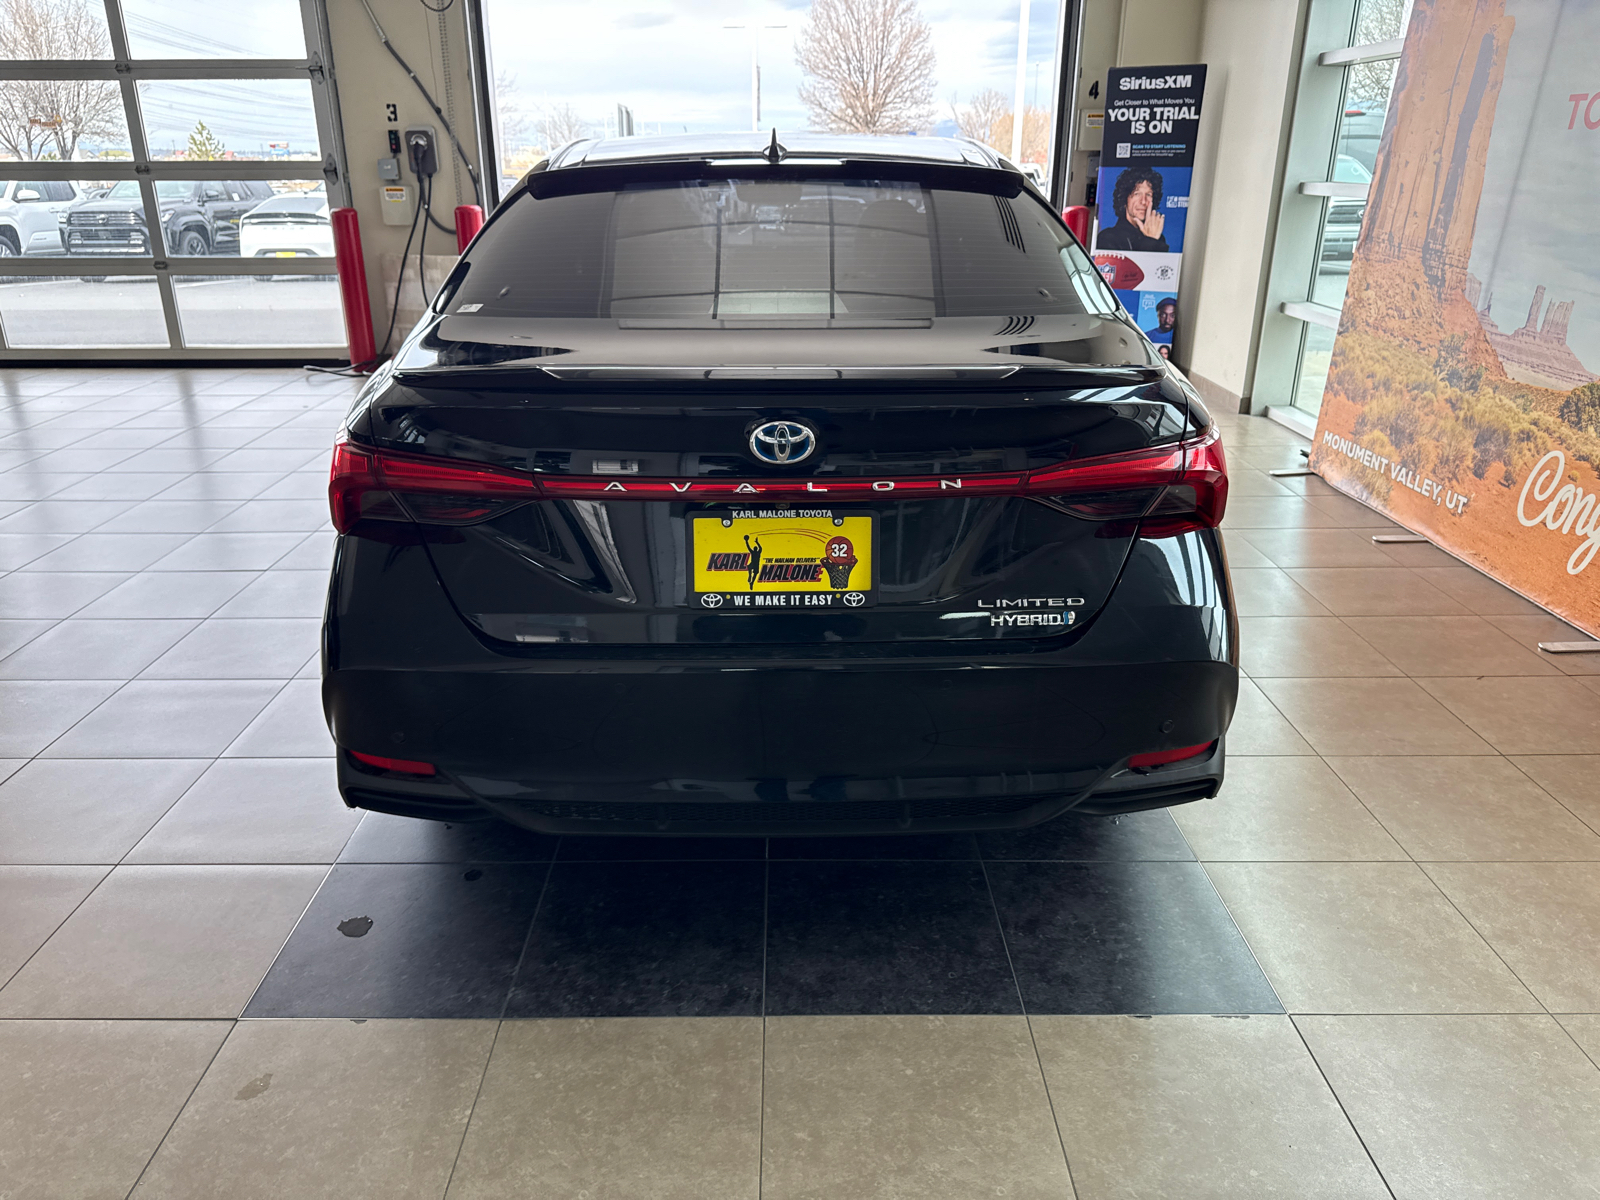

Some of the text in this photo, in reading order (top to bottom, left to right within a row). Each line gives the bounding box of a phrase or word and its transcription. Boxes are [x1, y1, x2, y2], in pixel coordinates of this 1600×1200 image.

[1088, 80, 1099, 100] 4
[1119, 75, 1192, 90] SiriusXM
[386, 104, 398, 122] 3
[1108, 106, 1199, 121] YOUR TRIAL
[1131, 121, 1173, 134] IS ON
[1322, 430, 1468, 514] MONUMENT VALLEY, UT
[604, 478, 962, 493] AVALON
[732, 509, 832, 519] KARL MALONE TOYOTA
[831, 543, 848, 557] 32
[706, 553, 750, 571] KARL
[757, 564, 823, 582] MALONE
[734, 594, 832, 605] WE MAKE IT EASY
[977, 598, 1085, 607] LIMITED
[990, 614, 1061, 626] HYBRID
